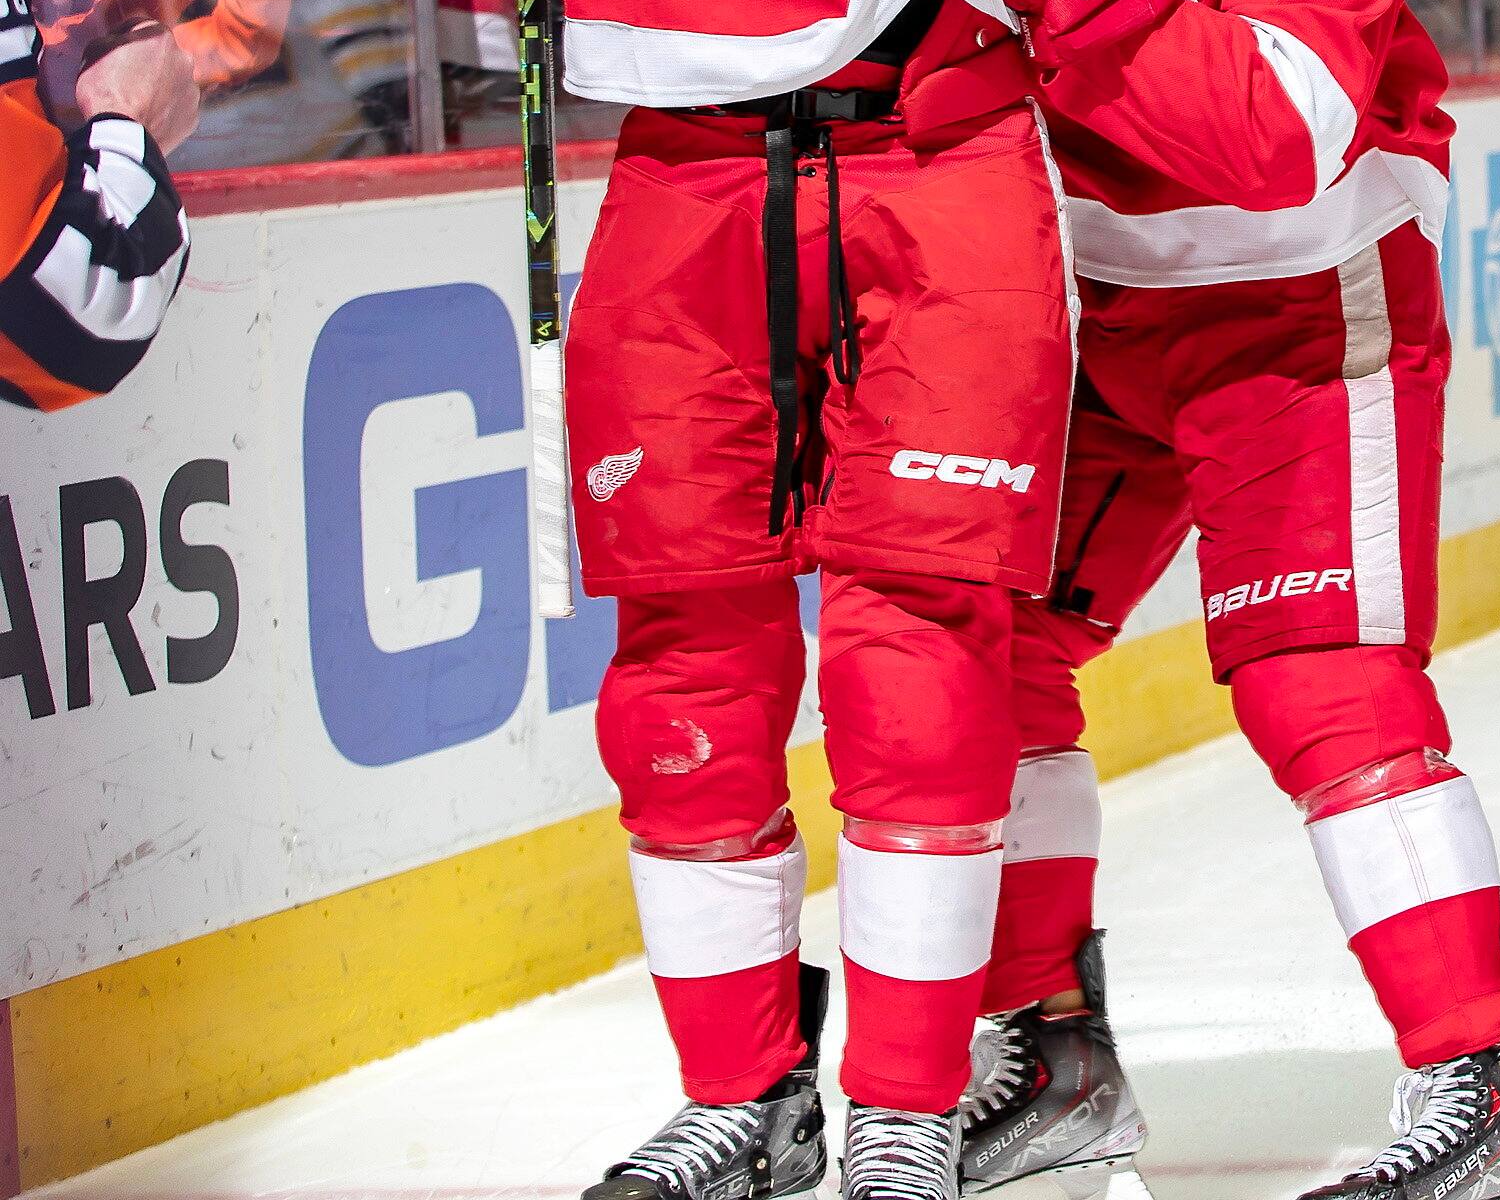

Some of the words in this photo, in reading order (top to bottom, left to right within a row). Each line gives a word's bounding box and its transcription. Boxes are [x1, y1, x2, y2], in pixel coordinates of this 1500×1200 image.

[889, 449, 1036, 494] CCM
[1206, 568, 1353, 622] BAUER
[975, 1111, 1040, 1169] BAUER
[1433, 1144, 1490, 1200] BAUER
